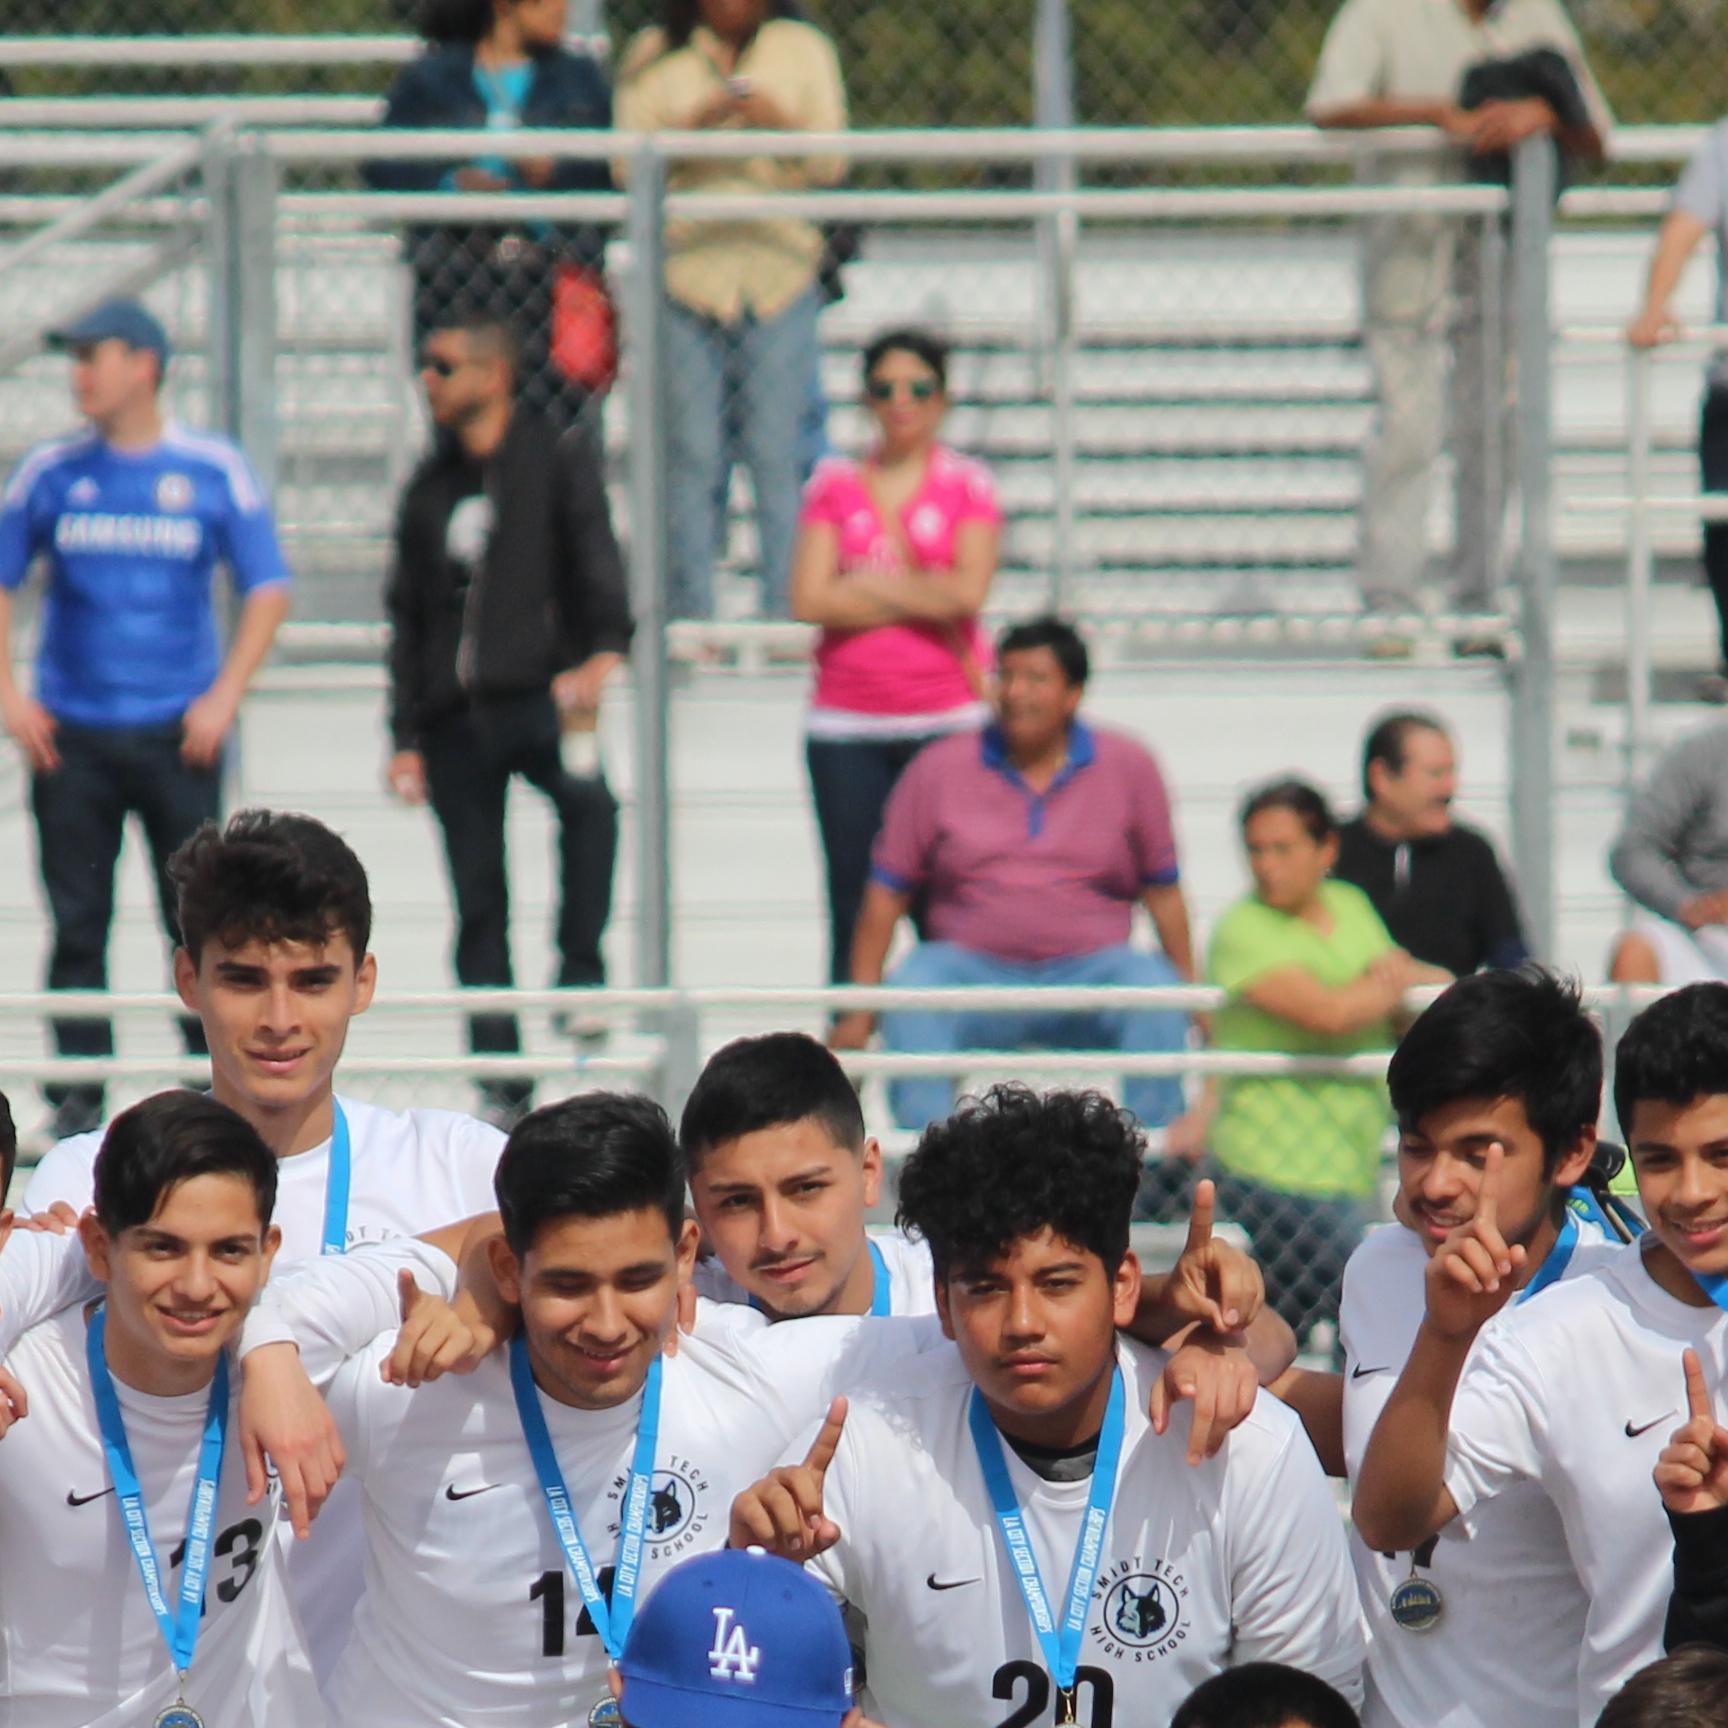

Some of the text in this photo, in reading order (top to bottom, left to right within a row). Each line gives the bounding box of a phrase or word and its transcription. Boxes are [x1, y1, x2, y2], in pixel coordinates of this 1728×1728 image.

[670, 1456, 709, 1492] TECH
[651, 1512, 708, 1560] SCHOOL
[1092, 1558, 1191, 1600] SMIDT TECH
[708, 1608, 759, 1681] LA
[1089, 1620, 1192, 1662] HIGH SCHOOL
